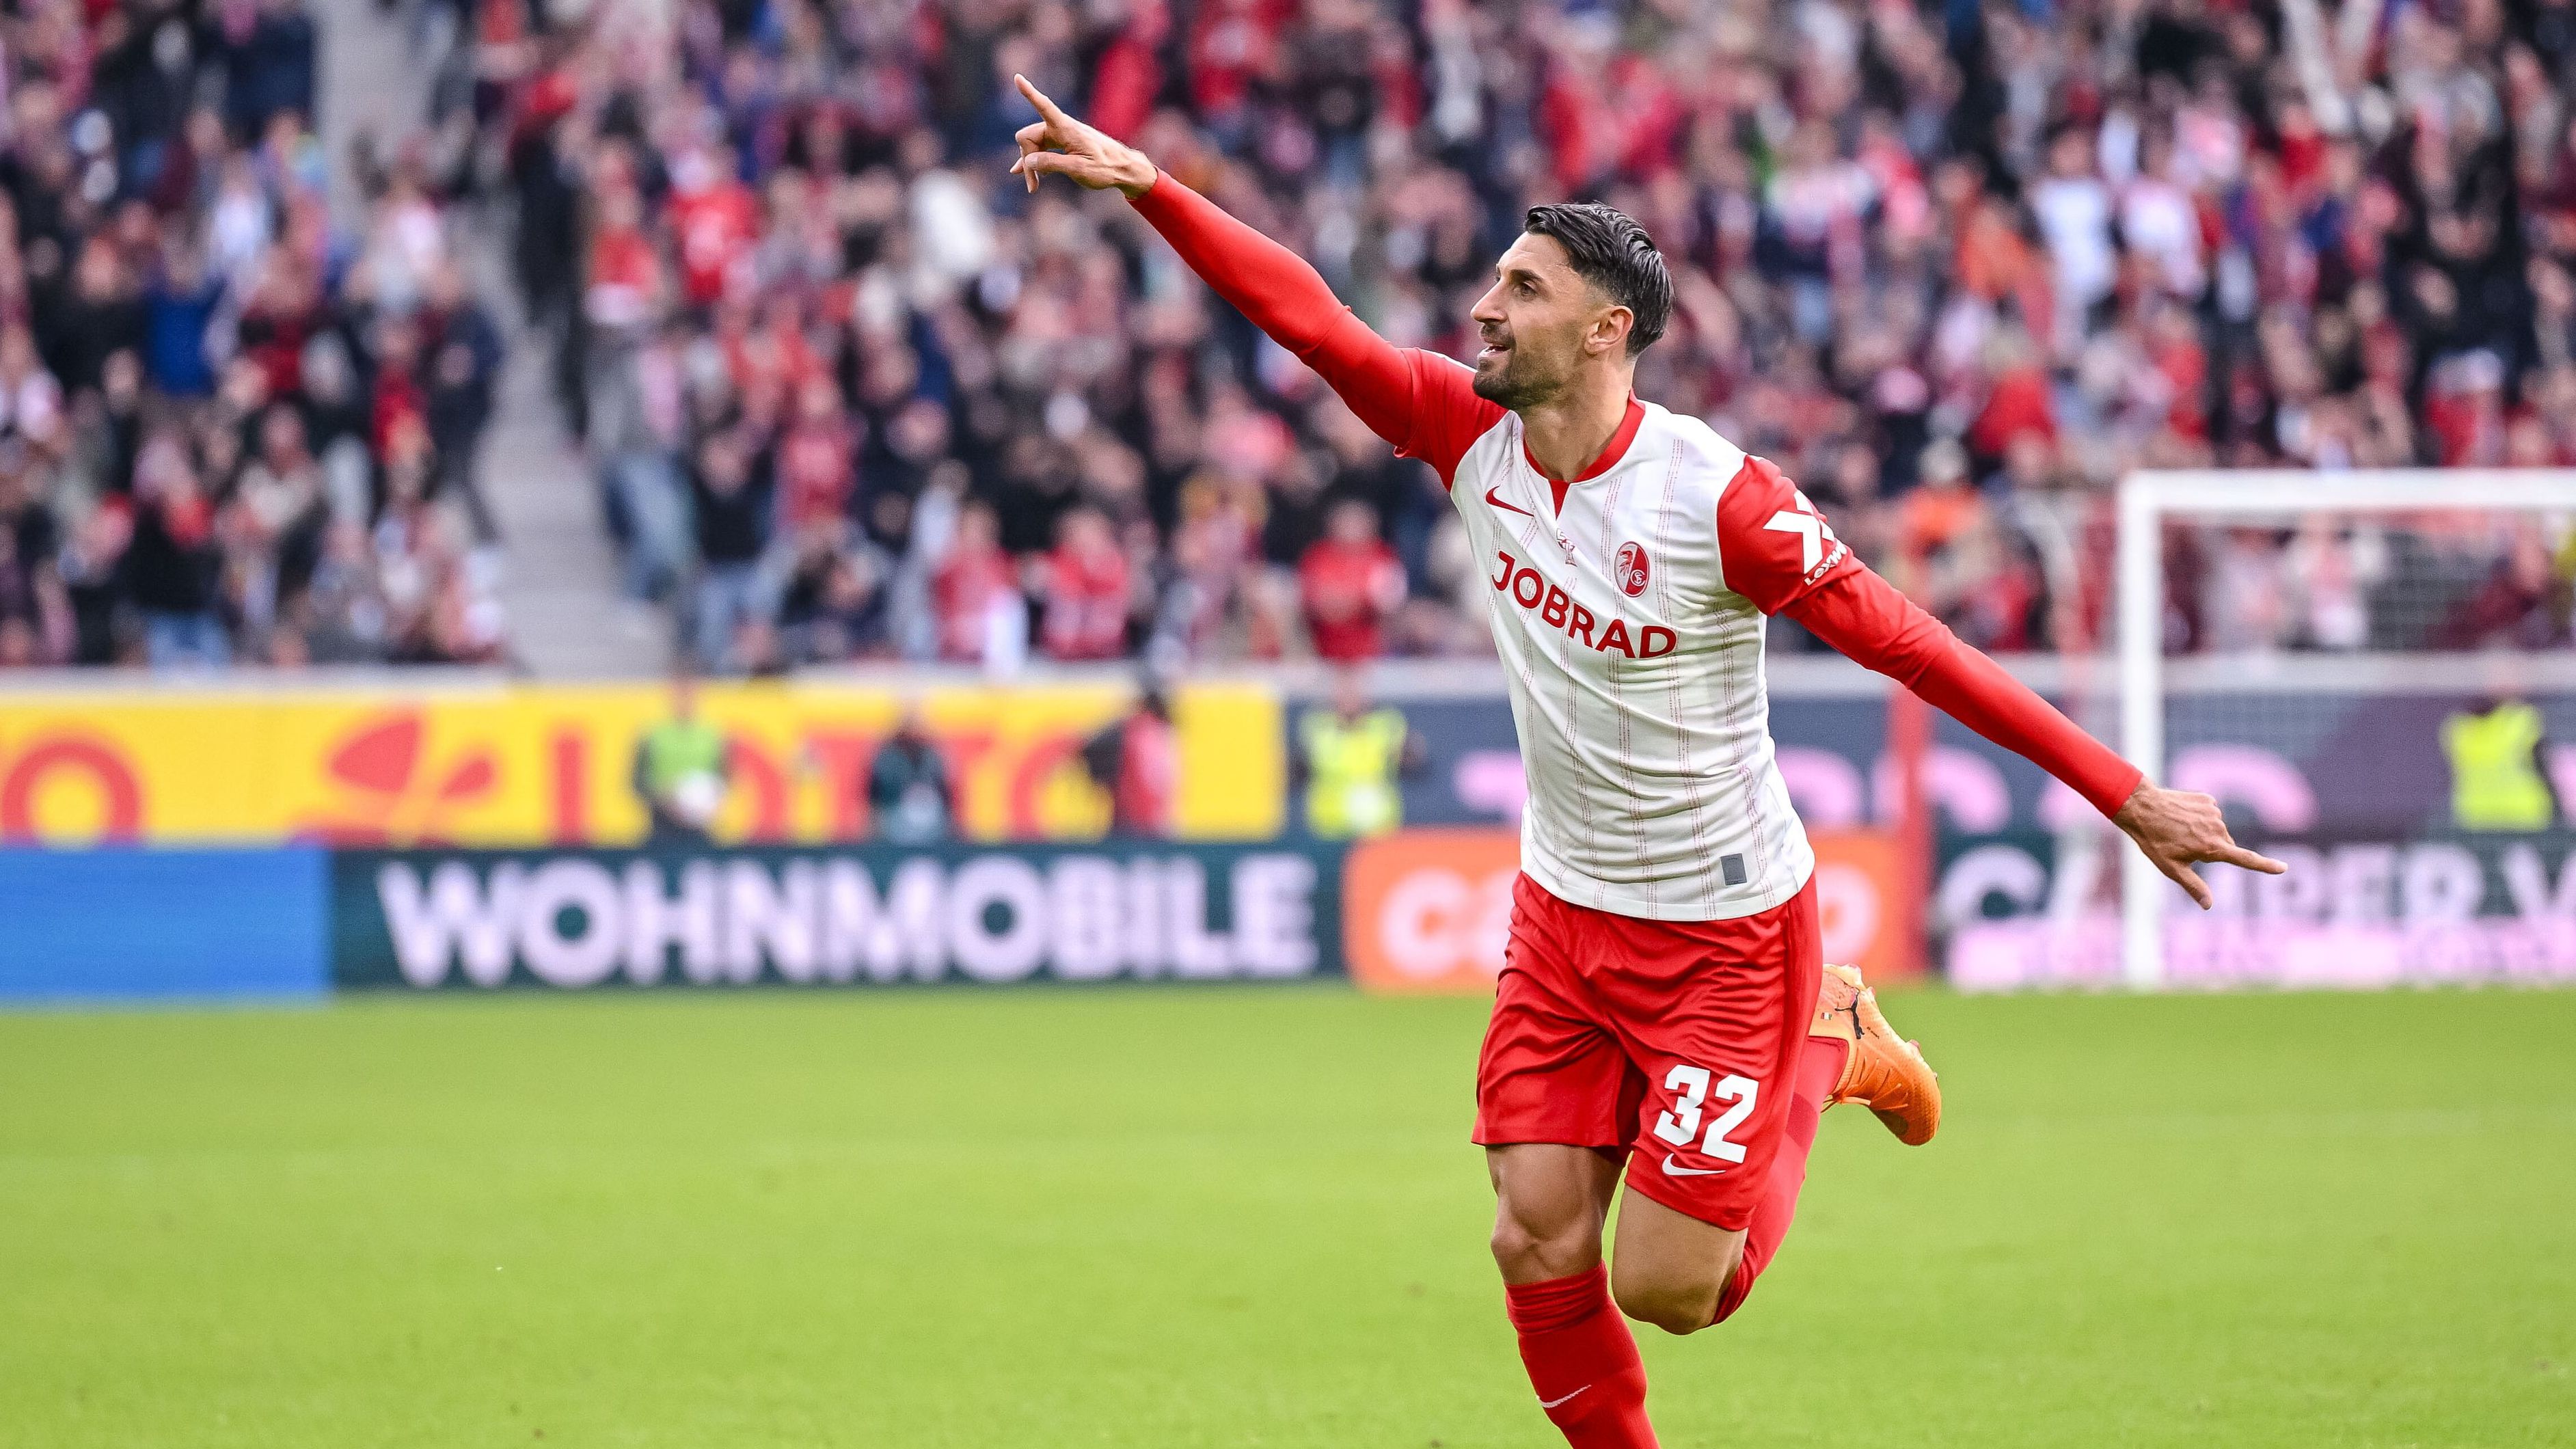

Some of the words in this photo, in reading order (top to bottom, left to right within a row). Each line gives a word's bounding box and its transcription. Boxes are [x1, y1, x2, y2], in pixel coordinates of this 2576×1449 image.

[1491, 550, 1679, 660] JOBRAD
[378, 860, 1316, 984] WOHNMOBILE
[1653, 1064, 1760, 1164] 32
